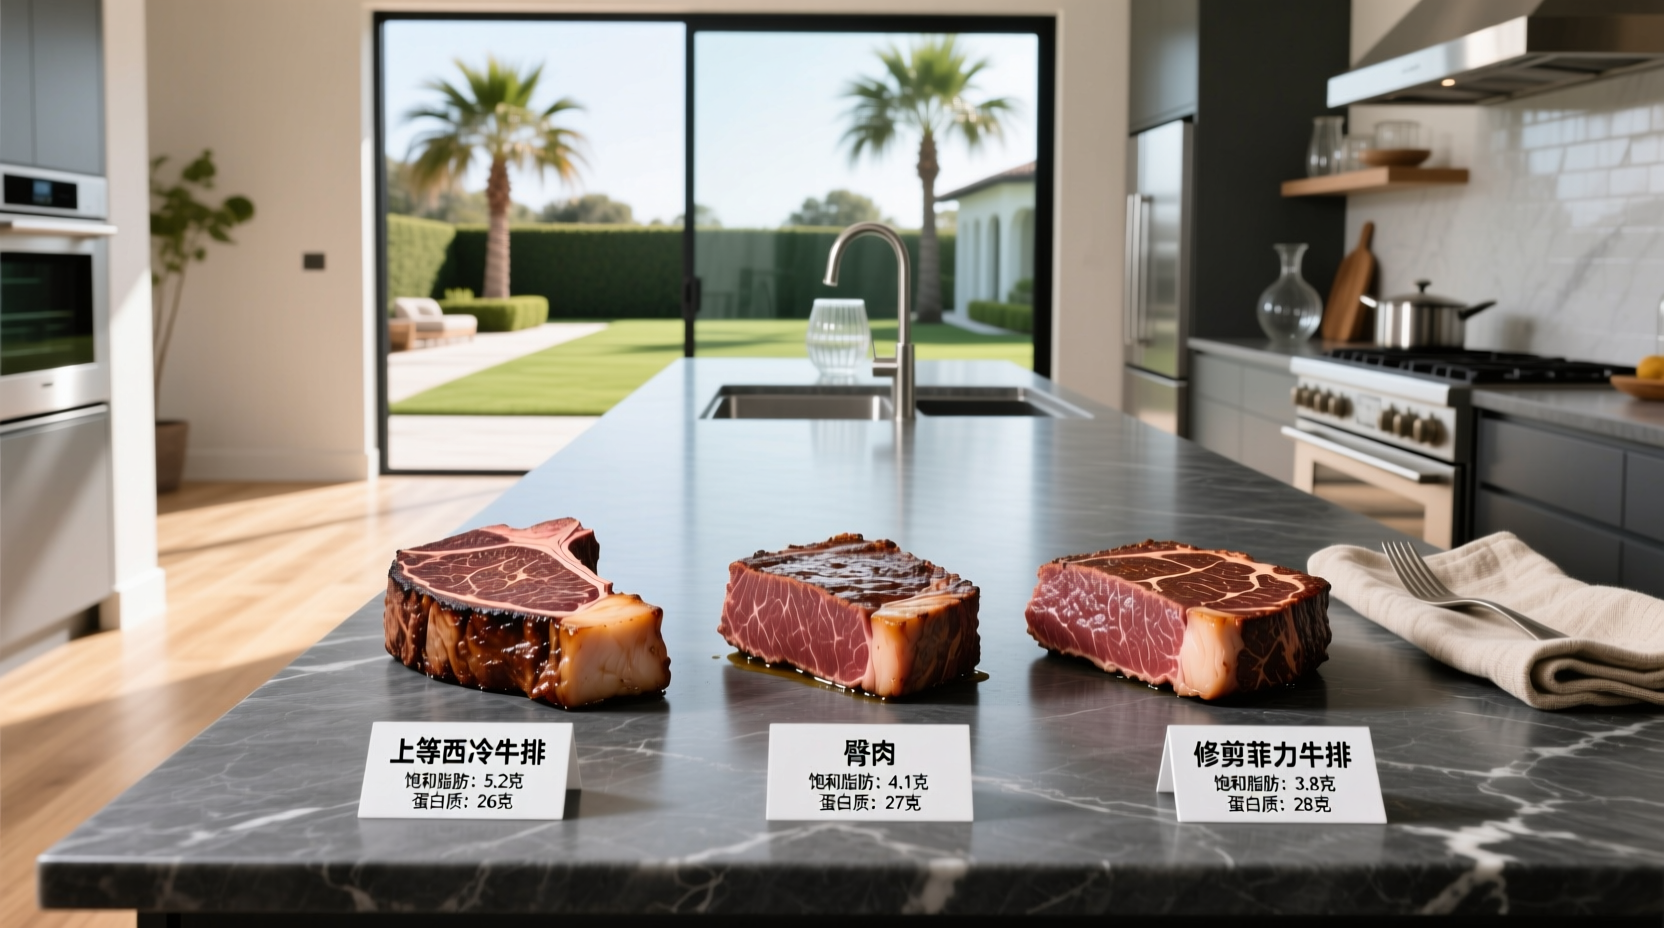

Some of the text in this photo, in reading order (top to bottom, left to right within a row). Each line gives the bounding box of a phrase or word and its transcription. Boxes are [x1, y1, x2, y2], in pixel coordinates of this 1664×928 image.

[389, 736, 547, 766] 上等西冷牛排
[843, 739, 896, 767] 臀肉
[1193, 740, 1352, 769] 修剪菲力牛排
